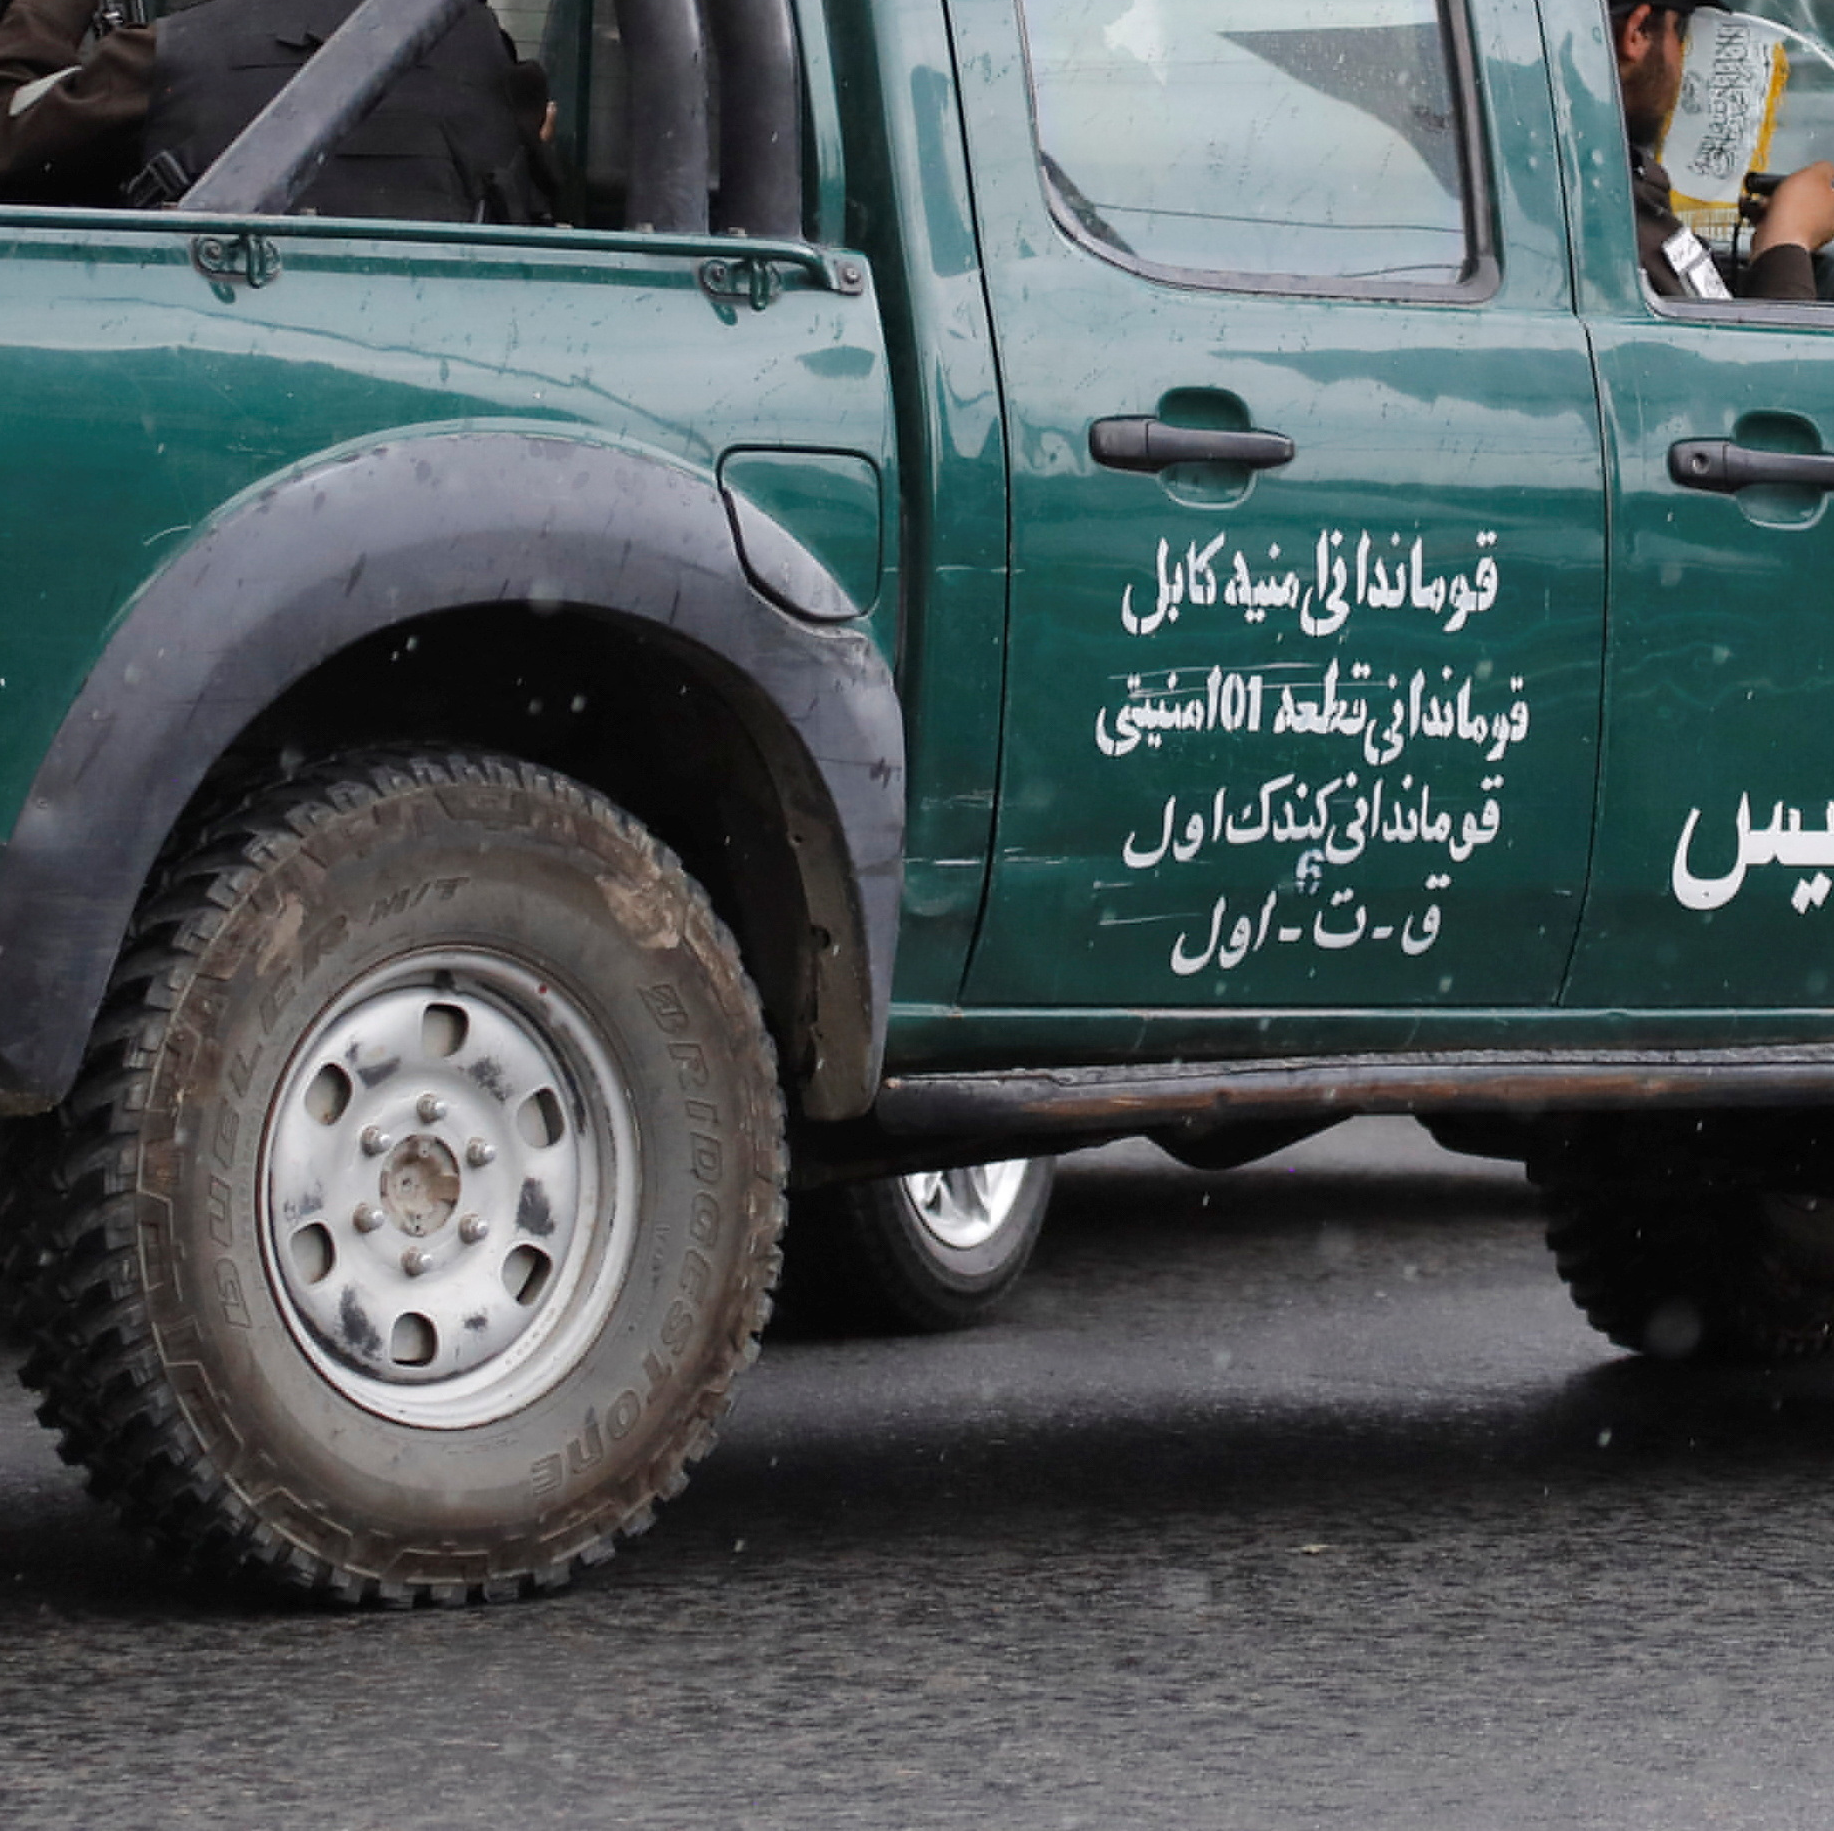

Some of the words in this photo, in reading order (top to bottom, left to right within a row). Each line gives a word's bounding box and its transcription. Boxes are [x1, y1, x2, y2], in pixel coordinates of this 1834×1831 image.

[1120, 531, 1227, 636] کابل
[1364, 665, 1530, 766] قوماندانی
[1121, 786, 1227, 869] اول
[1224, 772, 1343, 845] کندک
[1324, 770, 1506, 865] قوماندانی
[369, 874, 470, 926] M/T
[535, 981, 723, 1498] BRIDGESTONE
